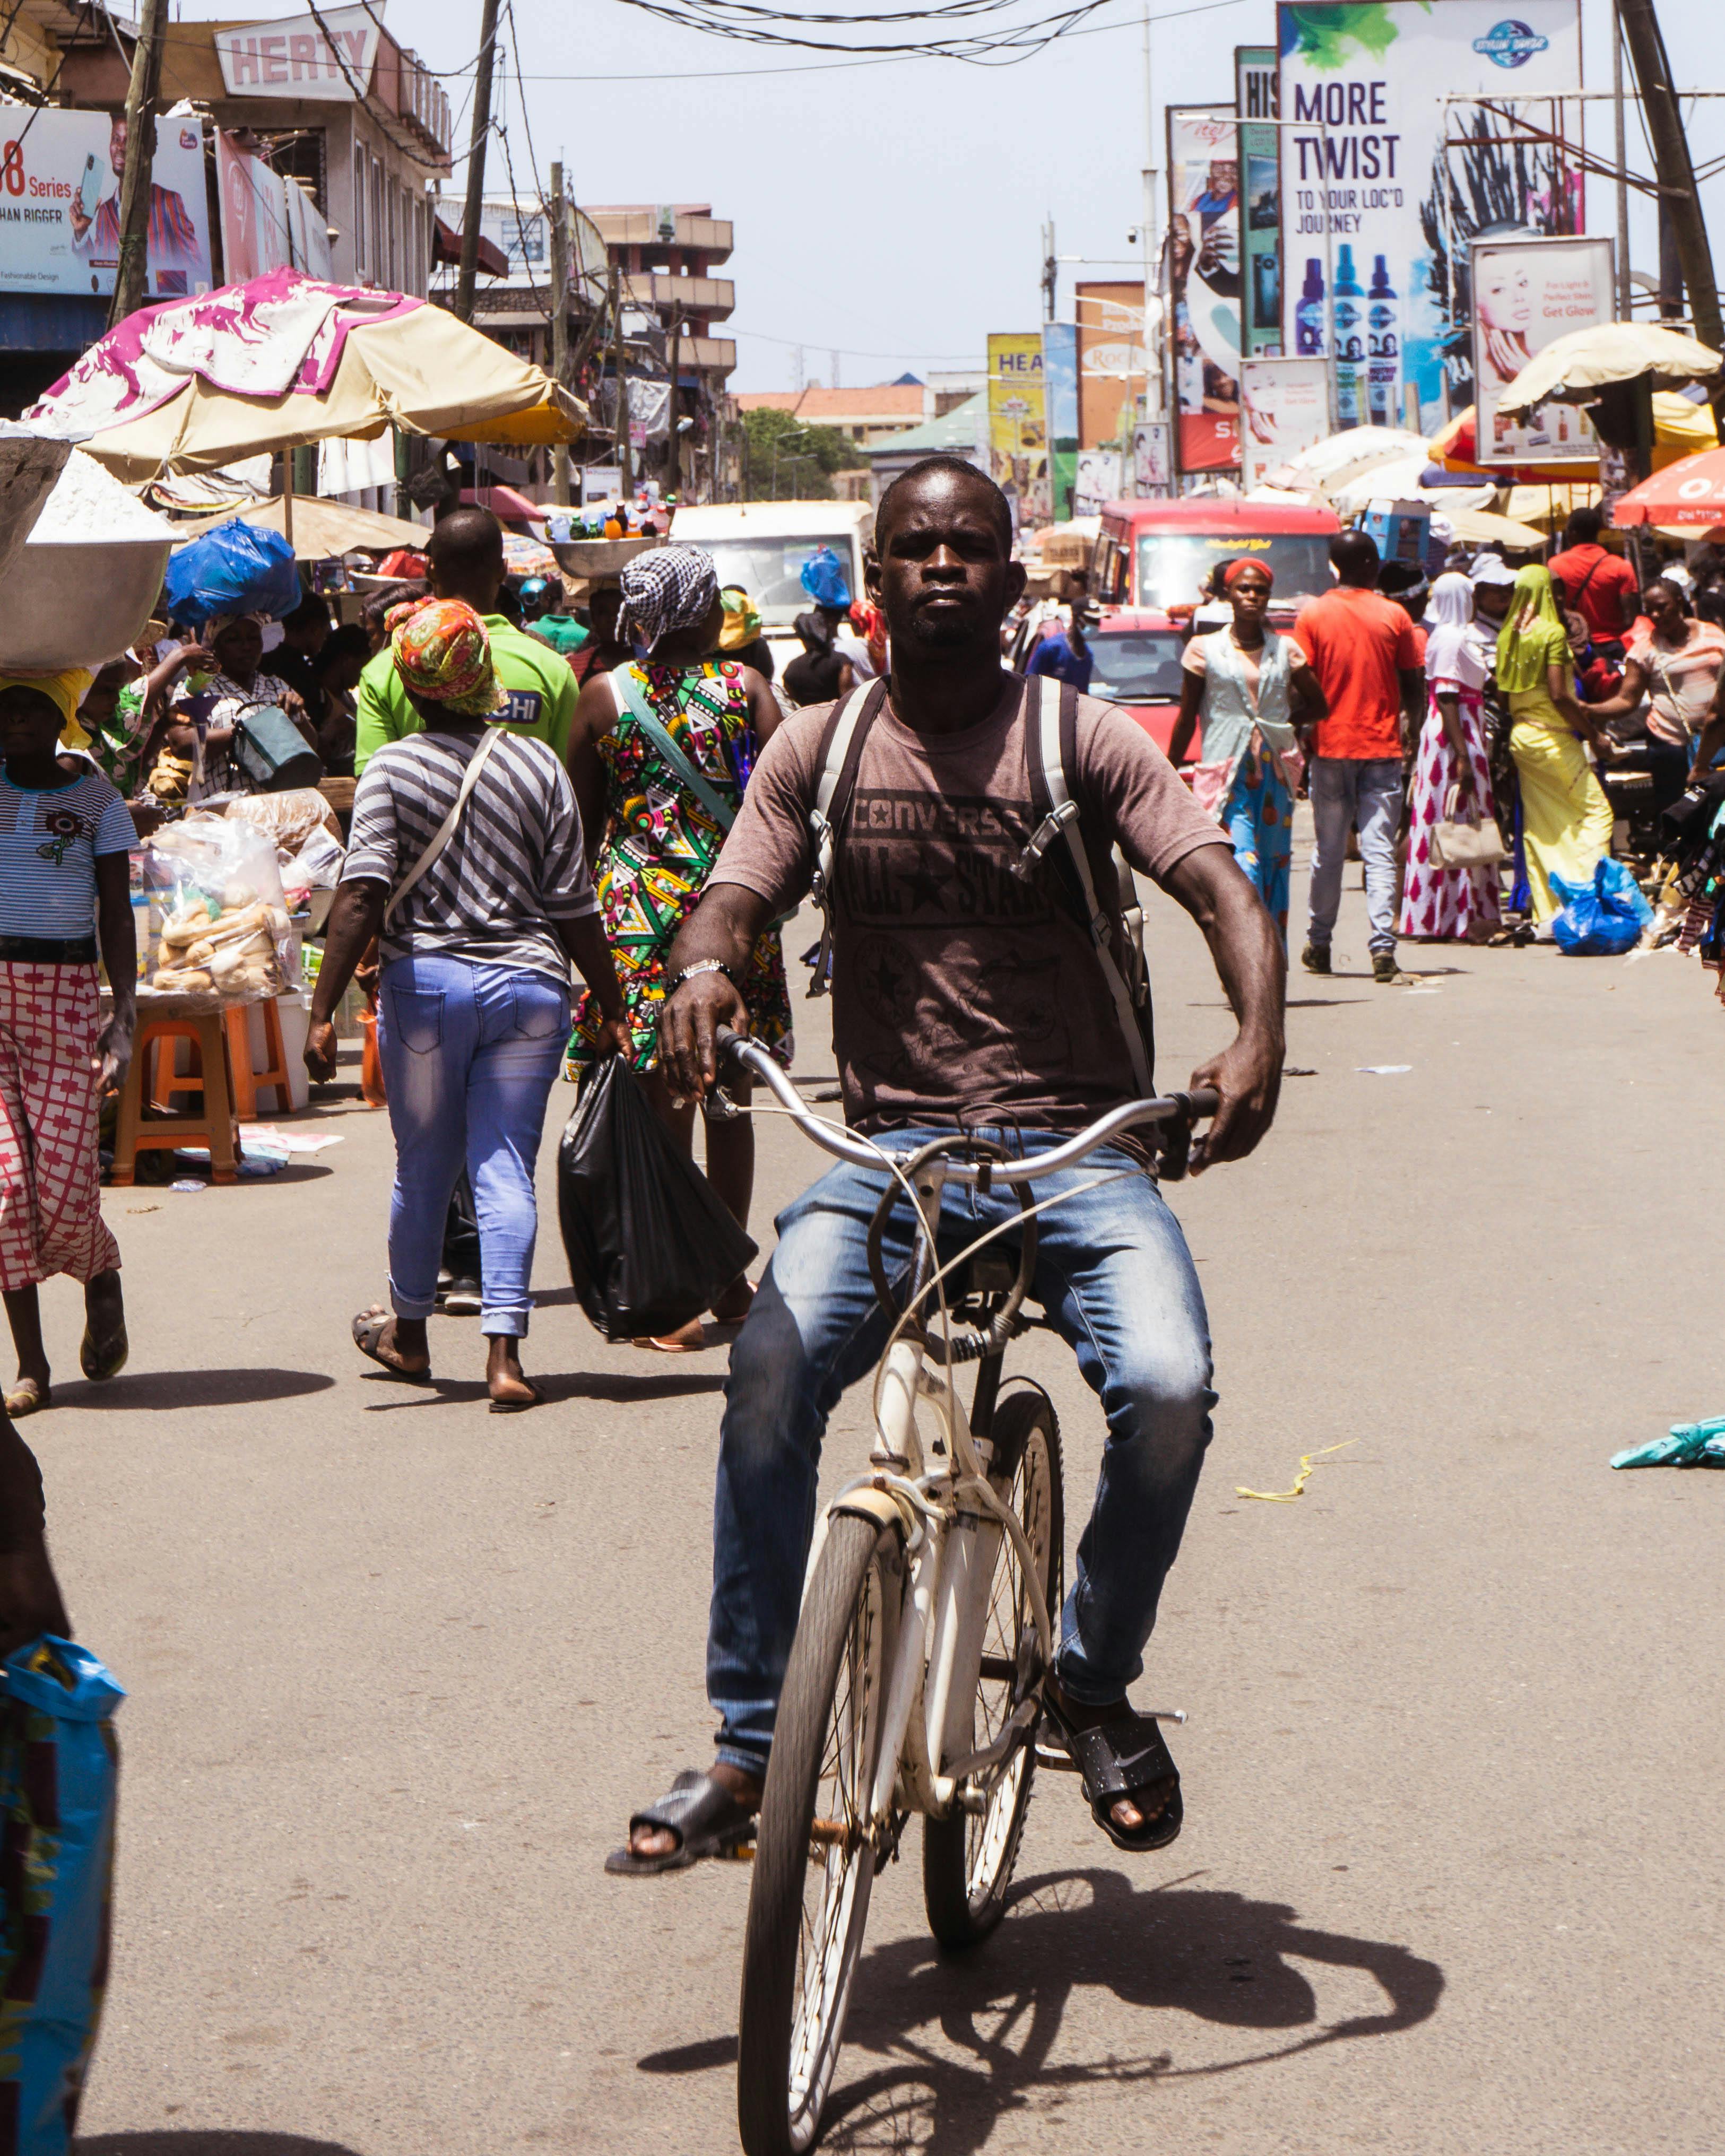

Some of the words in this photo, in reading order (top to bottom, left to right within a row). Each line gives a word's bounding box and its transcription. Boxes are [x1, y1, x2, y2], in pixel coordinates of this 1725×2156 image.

[231, 30, 367, 85] HERTY
[1295, 81, 1386, 126] MORE
[0, 139, 25, 197] 8
[29, 176, 72, 198] Series
[1294, 135, 1400, 180] TWIST
[1296, 190, 1314, 210] TO
[38, 273, 59, 282] Design
[1542, 306, 1563, 317] Get
